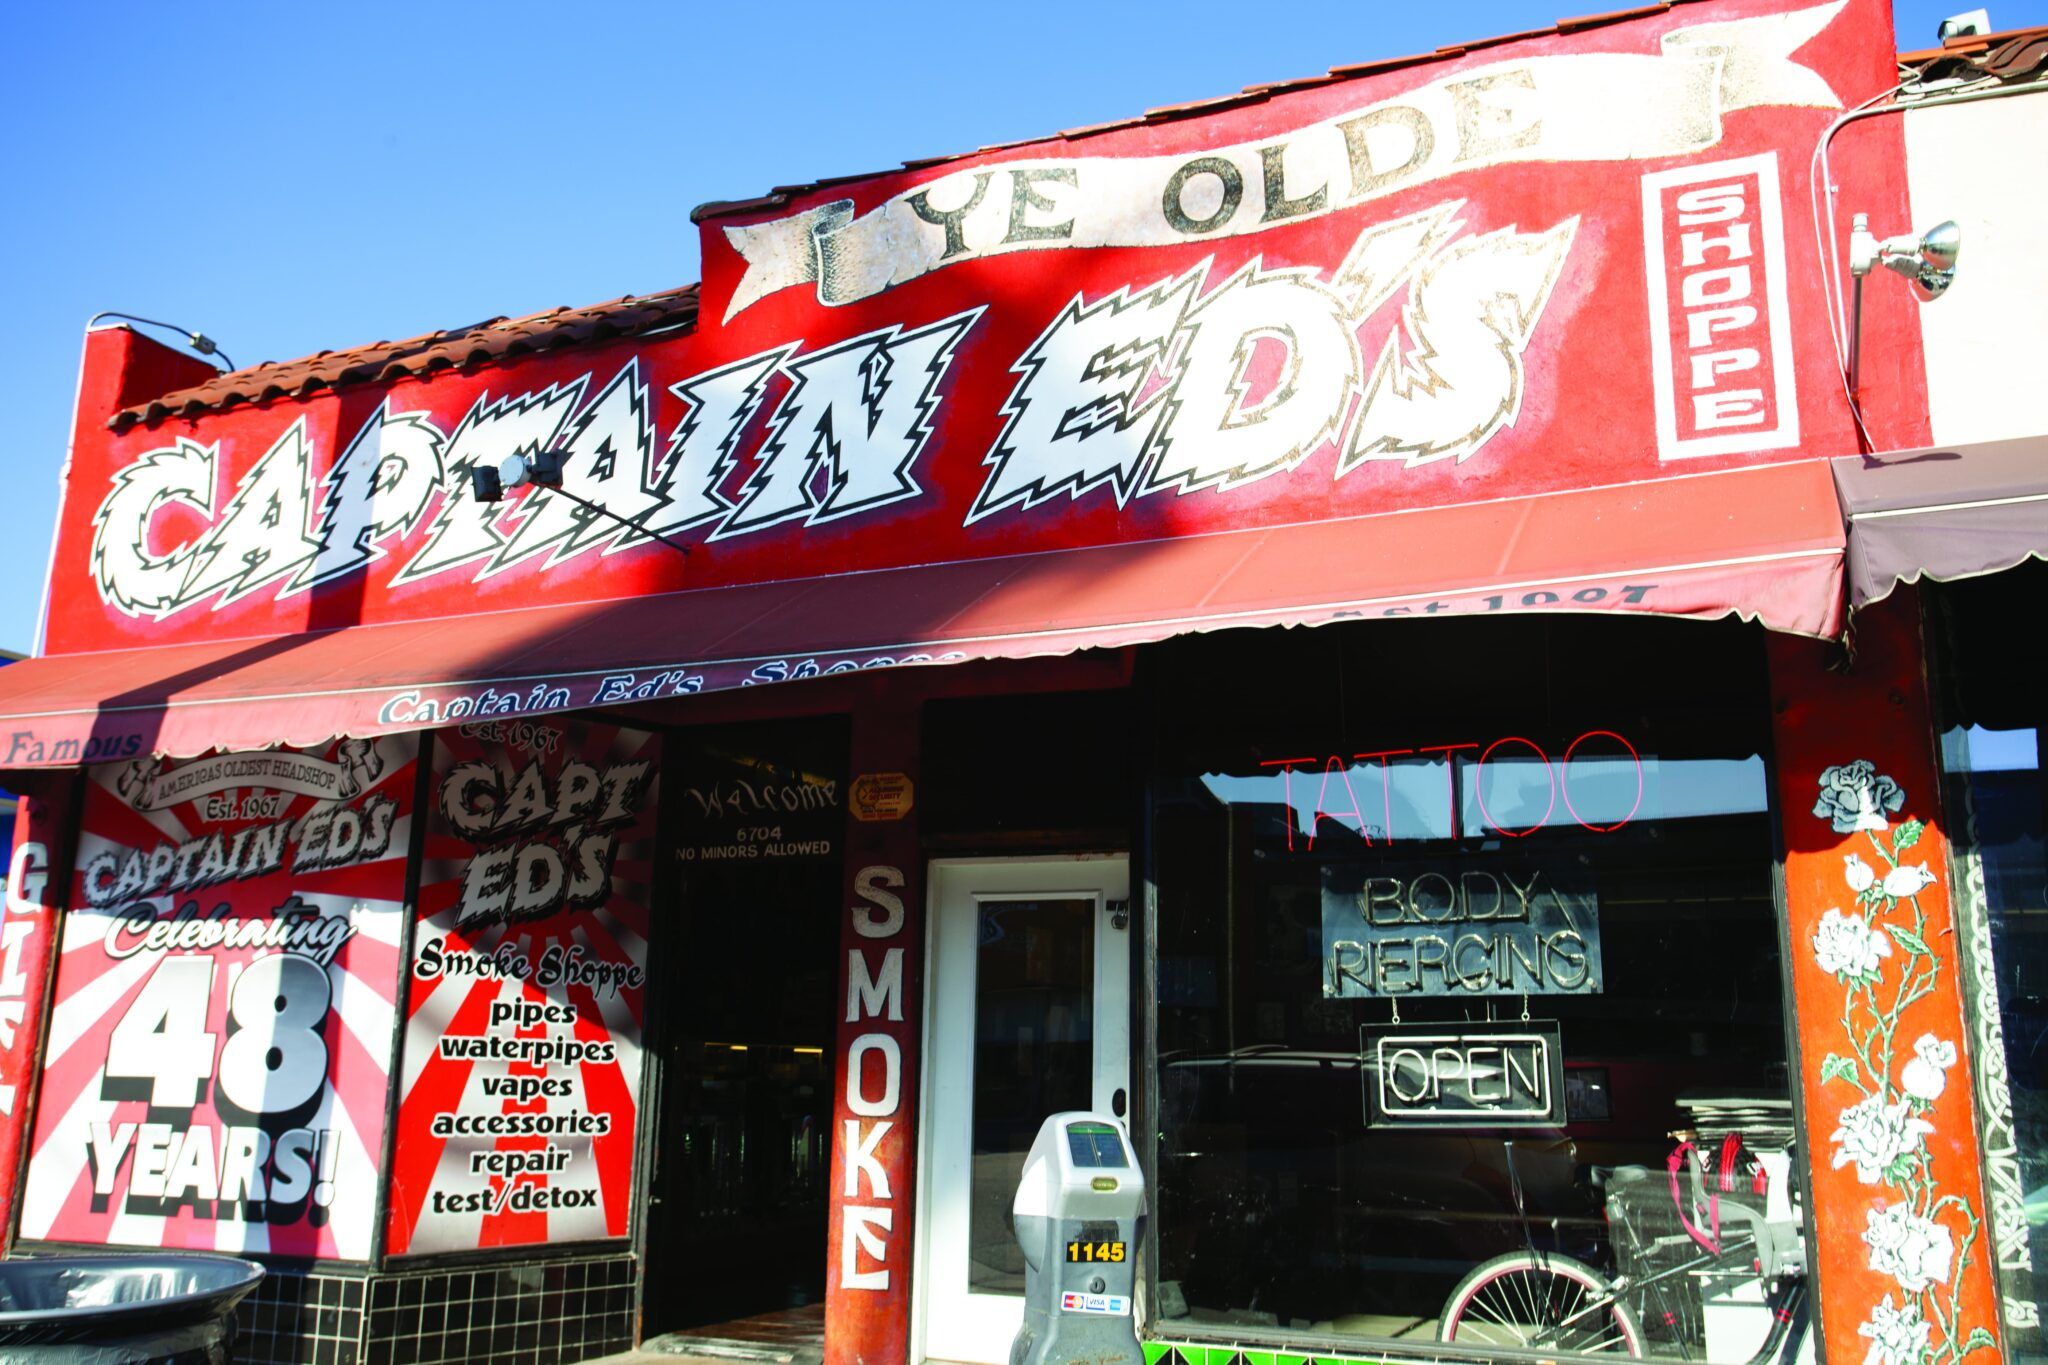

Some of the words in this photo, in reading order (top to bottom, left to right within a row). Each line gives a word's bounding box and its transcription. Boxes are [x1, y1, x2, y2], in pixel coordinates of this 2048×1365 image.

[904, 166, 1079, 259] YE
[1162, 67, 1541, 235] OLDE
[1675, 182, 1766, 431] SHOPPE
[91, 305, 989, 621] CAPTAIN
[964, 199, 1580, 527] ED'S
[378, 684, 570, 724] Captain
[590, 671, 703, 704] Ed's
[3, 731, 143, 764] Famous
[507, 720, 562, 754] 1967
[224, 759, 272, 778] OLDEST
[272, 759, 336, 791] HEADSHOP
[439, 757, 657, 838] CAPT
[684, 779, 839, 818] Welcome
[1261, 731, 1642, 851] TATTOO
[205, 798, 237, 820] Est.
[242, 796, 280, 819] 1967
[736, 825, 782, 842] 6704
[82, 819, 295, 909] CAPTAIN
[291, 792, 400, 875] ED'S
[454, 824, 617, 930] ED'S
[676, 847, 695, 860] NO
[701, 845, 758, 860] MINORS
[764, 841, 830, 857] ALLOWED
[1358, 870, 1540, 926] BODY
[104, 896, 359, 968] Celebrating
[415, 938, 532, 980] Smoke
[537, 944, 645, 999] Shoppe
[1328, 930, 1588, 992] PIERCING
[103, 952, 332, 1118] 48
[491, 996, 577, 1027] pipes
[440, 1035, 616, 1066] waterpipes
[1389, 1046, 1542, 1102] OPEN
[481, 1077, 573, 1102] vapes
[840, 865, 905, 1290] SMOKE
[432, 1109, 609, 1135] accessories
[88, 1122, 341, 1212] YEARS!
[470, 1146, 570, 1178] repair
[432, 1183, 598, 1213] test/detox
[1068, 1242, 1125, 1262] 1145
[1089, 1298, 1105, 1307] VISA
